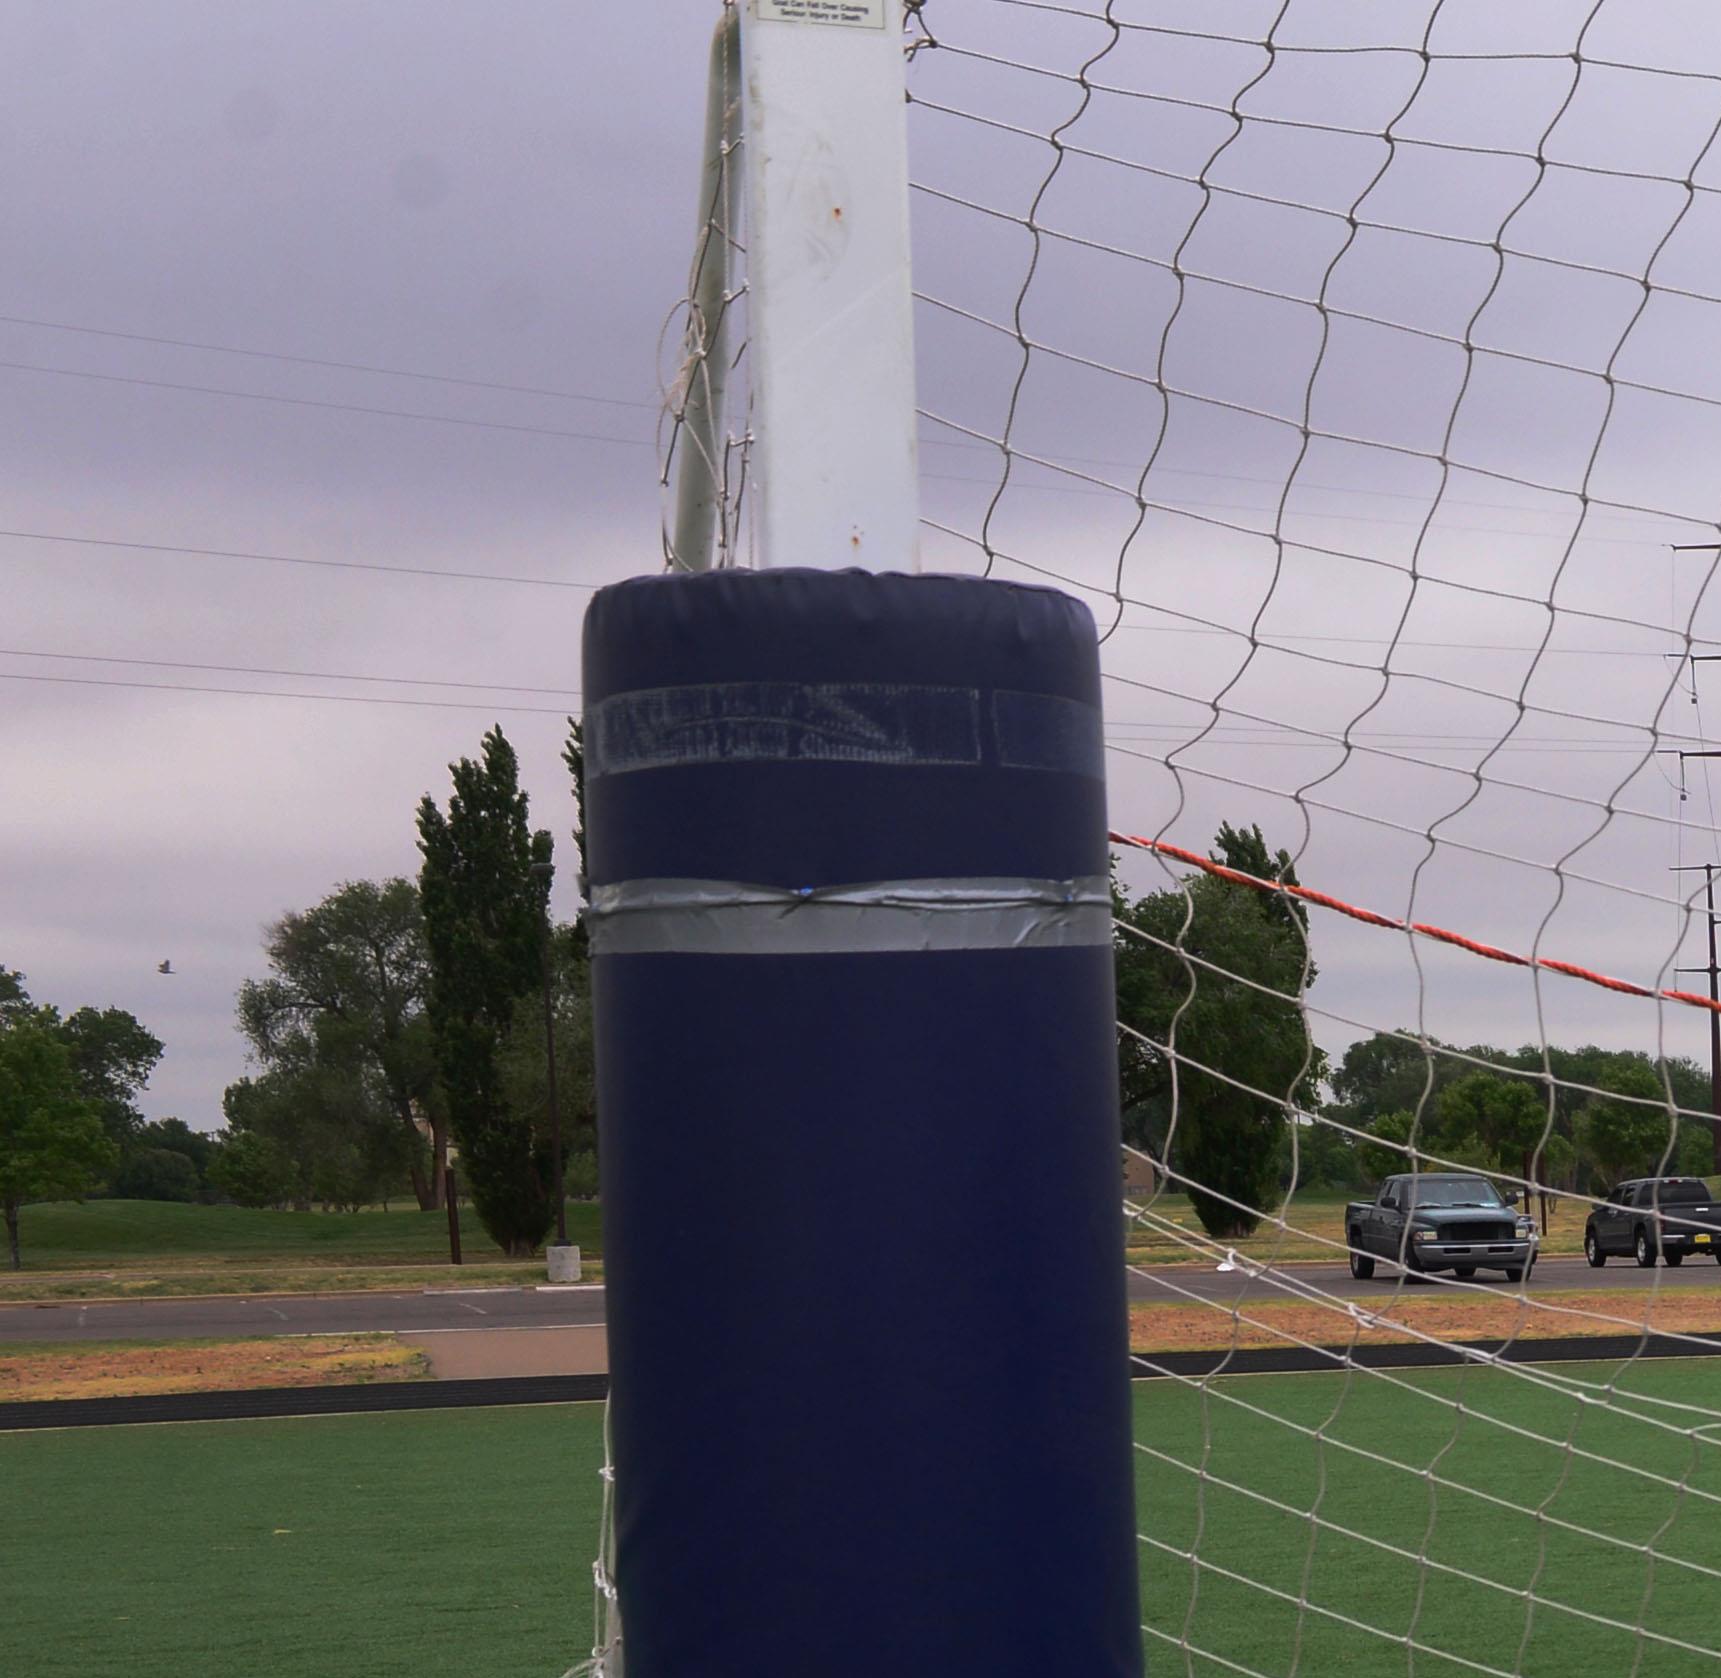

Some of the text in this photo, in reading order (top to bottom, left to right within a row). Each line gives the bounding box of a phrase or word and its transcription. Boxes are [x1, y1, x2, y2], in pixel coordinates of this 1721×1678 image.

[840, 4, 869, 15] Causing
[809, 11, 829, 20] Injury
[841, 13, 861, 21] Death
